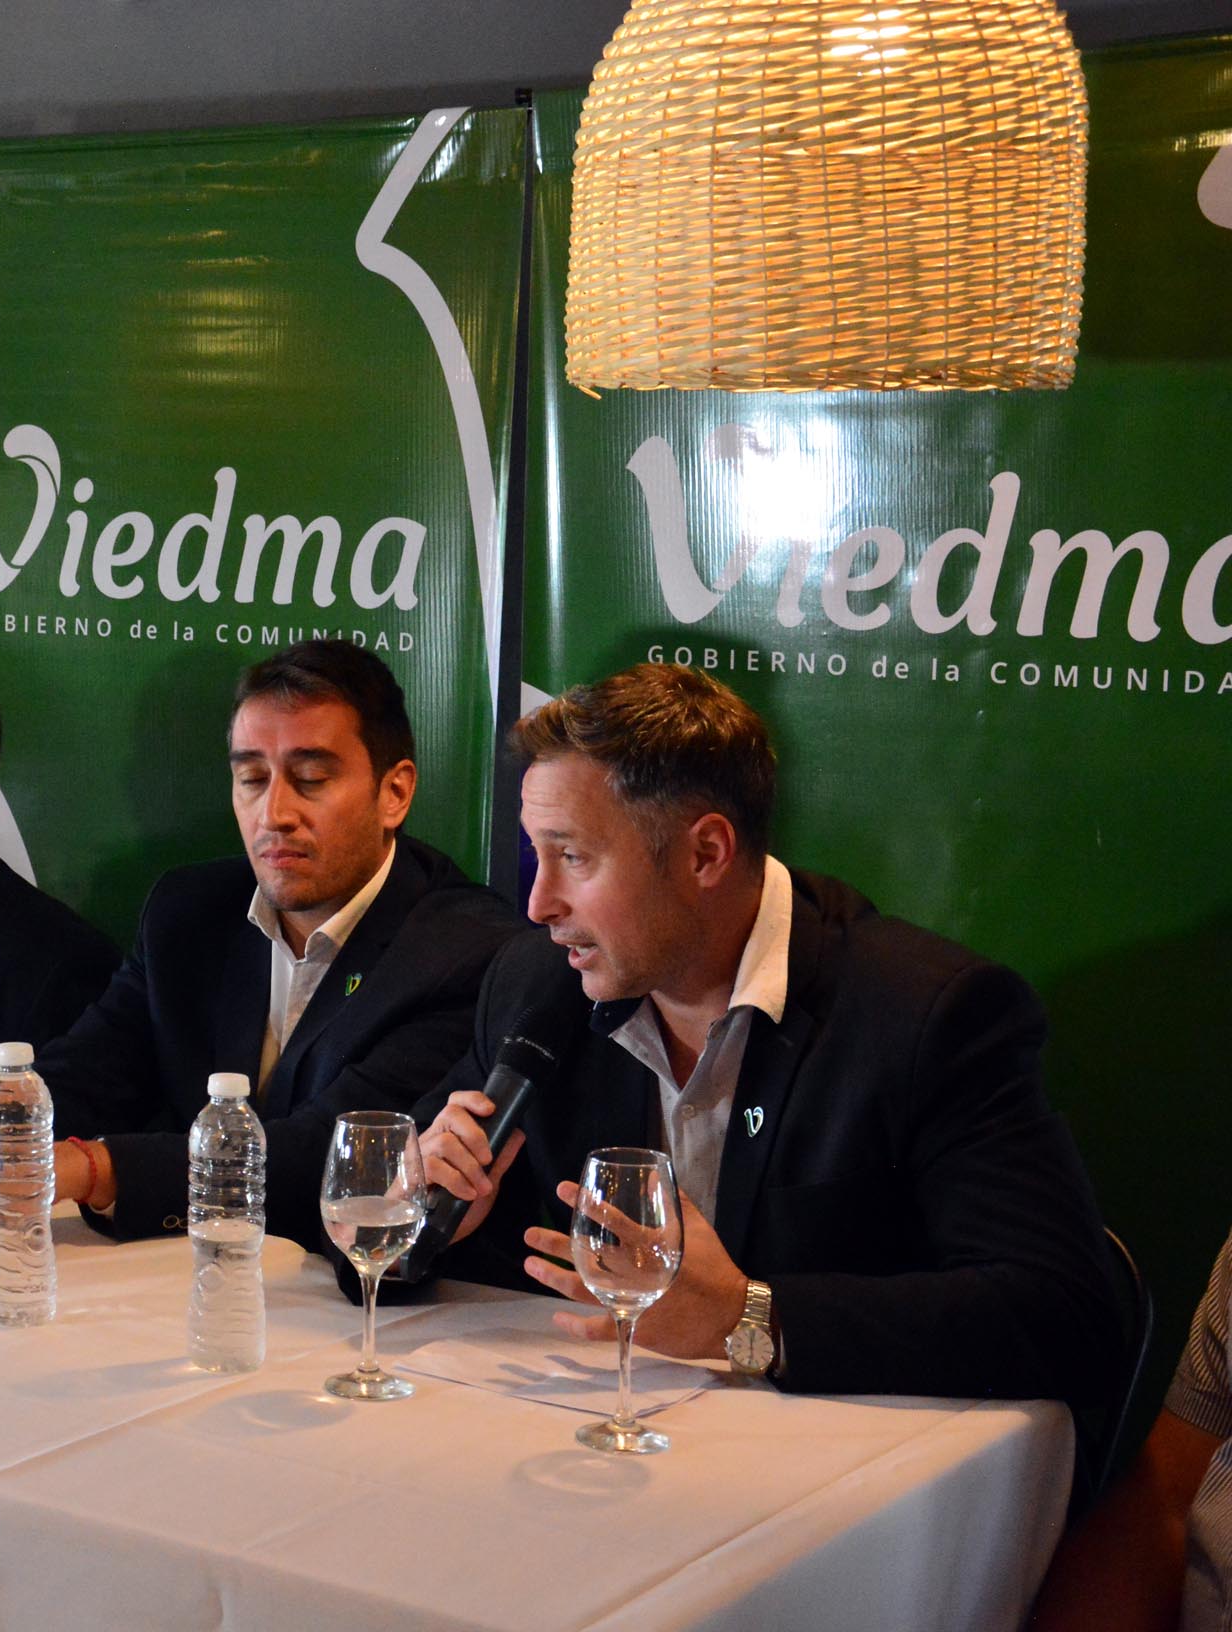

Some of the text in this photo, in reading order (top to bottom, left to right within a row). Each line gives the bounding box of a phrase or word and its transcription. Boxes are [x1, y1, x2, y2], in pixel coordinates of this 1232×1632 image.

[129, 619, 157, 640] de
[173, 621, 194, 641] la
[647, 645, 847, 676] GOBIERNO
[871, 655, 909, 679] de
[931, 658, 960, 682] la
